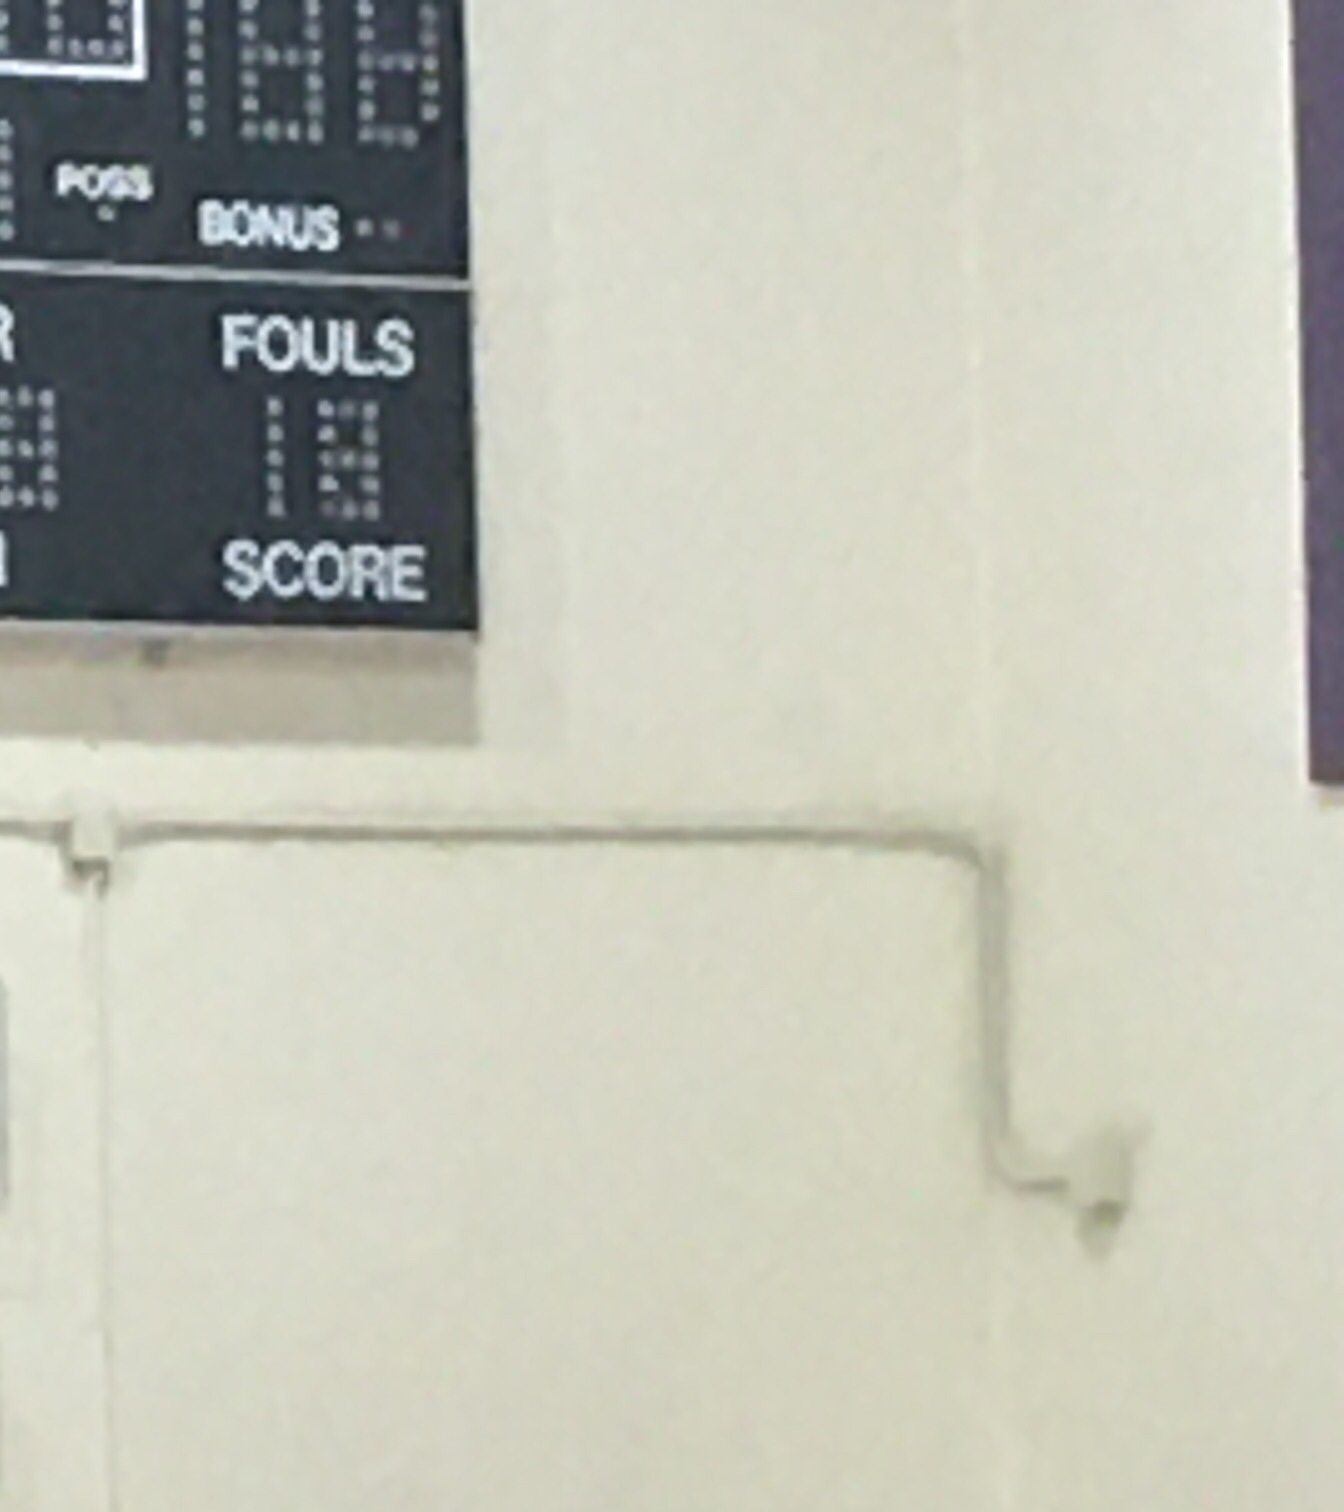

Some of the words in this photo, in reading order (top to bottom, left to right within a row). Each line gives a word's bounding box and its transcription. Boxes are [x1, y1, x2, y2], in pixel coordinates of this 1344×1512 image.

[198, 202, 339, 250] BONUS
[221, 315, 415, 377] FOULS
[223, 541, 427, 601] SCORE
